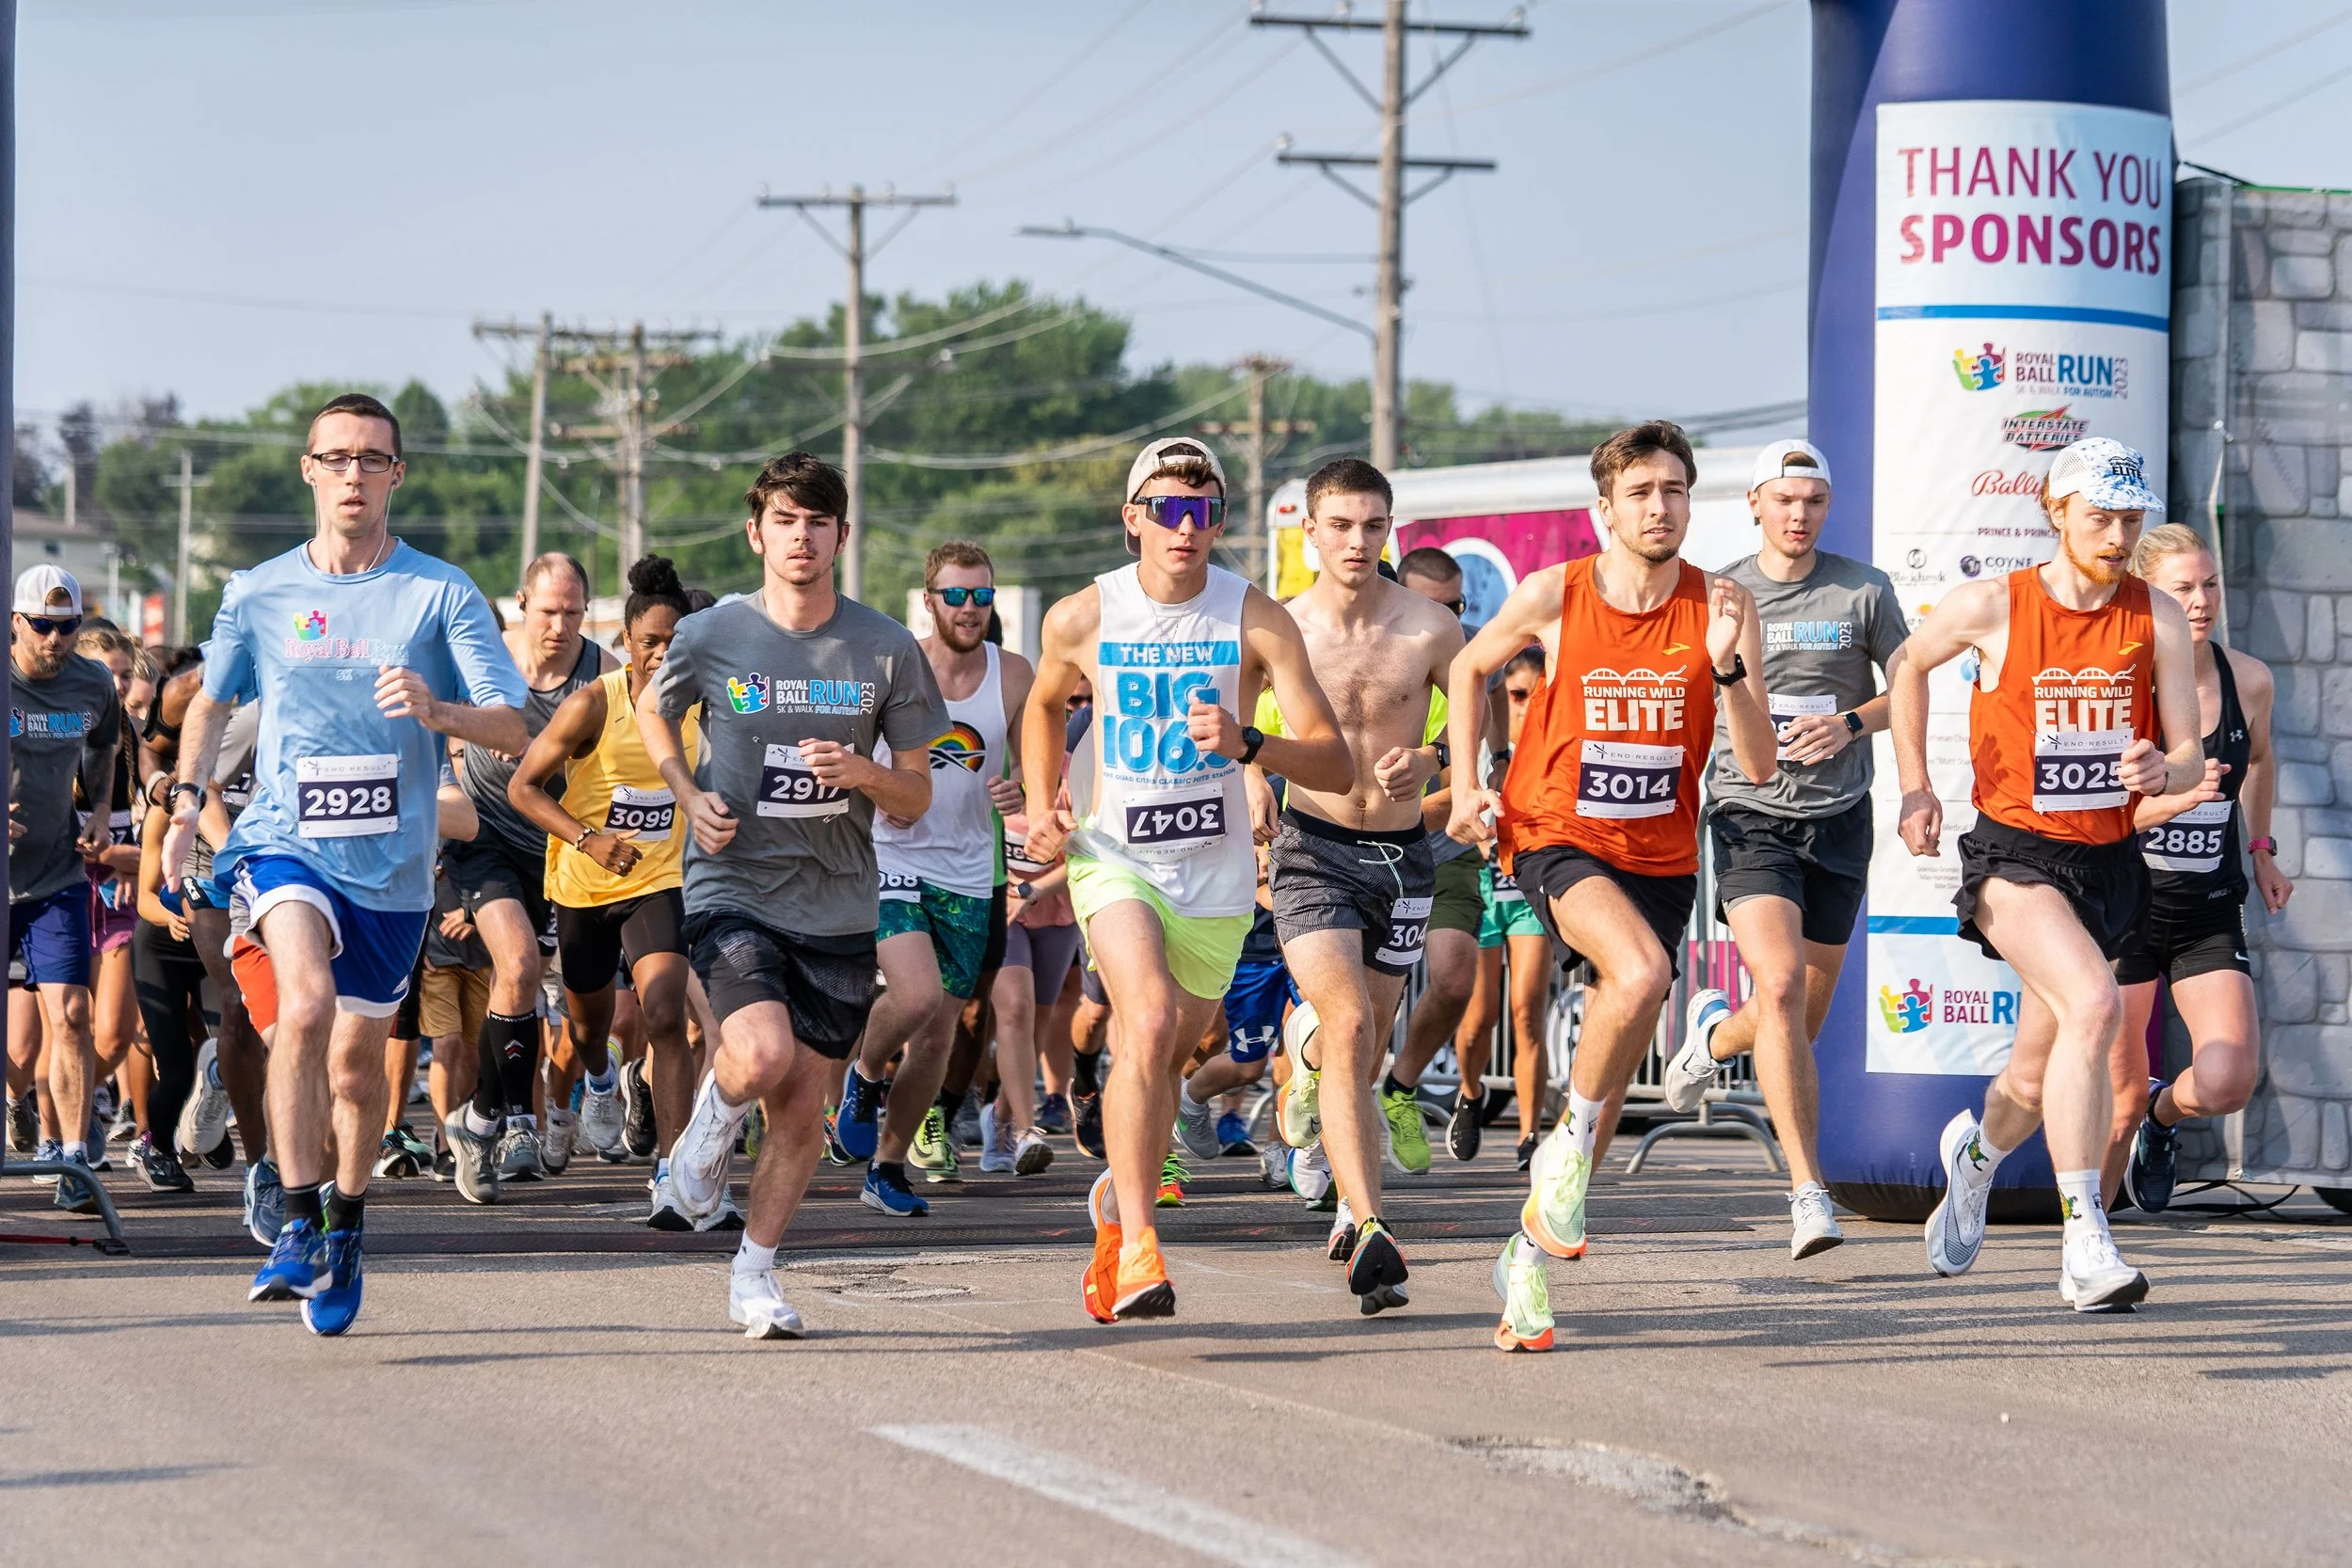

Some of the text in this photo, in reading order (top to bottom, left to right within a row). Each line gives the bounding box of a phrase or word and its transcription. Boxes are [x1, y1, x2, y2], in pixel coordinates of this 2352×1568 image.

[1898, 147, 2161, 210] THANK YOU
[1899, 214, 2161, 276] SPONSORS
[2016, 353, 2055, 365] ROYAL
[2016, 367, 2055, 383] BALL
[2058, 355, 2112, 386] RUN
[2004, 420, 2087, 431] INTERSTATE
[2006, 433, 2081, 442] BATTERIES
[2112, 467, 2143, 481] ELITE
[1972, 469, 2042, 502] Bally
[1978, 528, 2011, 537] PRINCE
[1767, 622, 1793, 632] ROYAL
[1794, 621, 1838, 642] RUN
[1839, 621, 1851, 650] 2023
[1767, 631, 1793, 643] BALL
[285, 639, 332, 663] Royal
[336, 638, 369, 658] Ball
[1120, 646, 1214, 663] THE NEW
[776, 680, 808, 690] ROYAL
[809, 679, 860, 705] RUN
[1583, 686, 1686, 699] RUNNING WILD
[2034, 686, 2133, 698] RUNNING WILD
[776, 690, 808, 705] BALL
[861, 682, 875, 715] 2023
[1117, 671, 1220, 720] BIG
[27, 713, 48, 721] ROYAL
[815, 705, 832, 714] FOR
[832, 705, 859, 715] AUTISM
[1584, 698, 1685, 732] ELITE
[2035, 698, 2132, 732] ELITE
[27, 722, 48, 732] BALL
[49, 713, 83, 732] RUN
[1212, 768, 1236, 779] STATION
[2040, 761, 2123, 790] 3025
[1587, 770, 1671, 800] 3014
[305, 786, 391, 816] 2928
[610, 808, 673, 829] 3099
[1131, 804, 1219, 837] 3047
[2146, 828, 2222, 853] 2885
[1944, 990, 1989, 1005] ROYAL
[1944, 1006, 1989, 1023] BALL
[1993, 991, 2021, 1024] R
